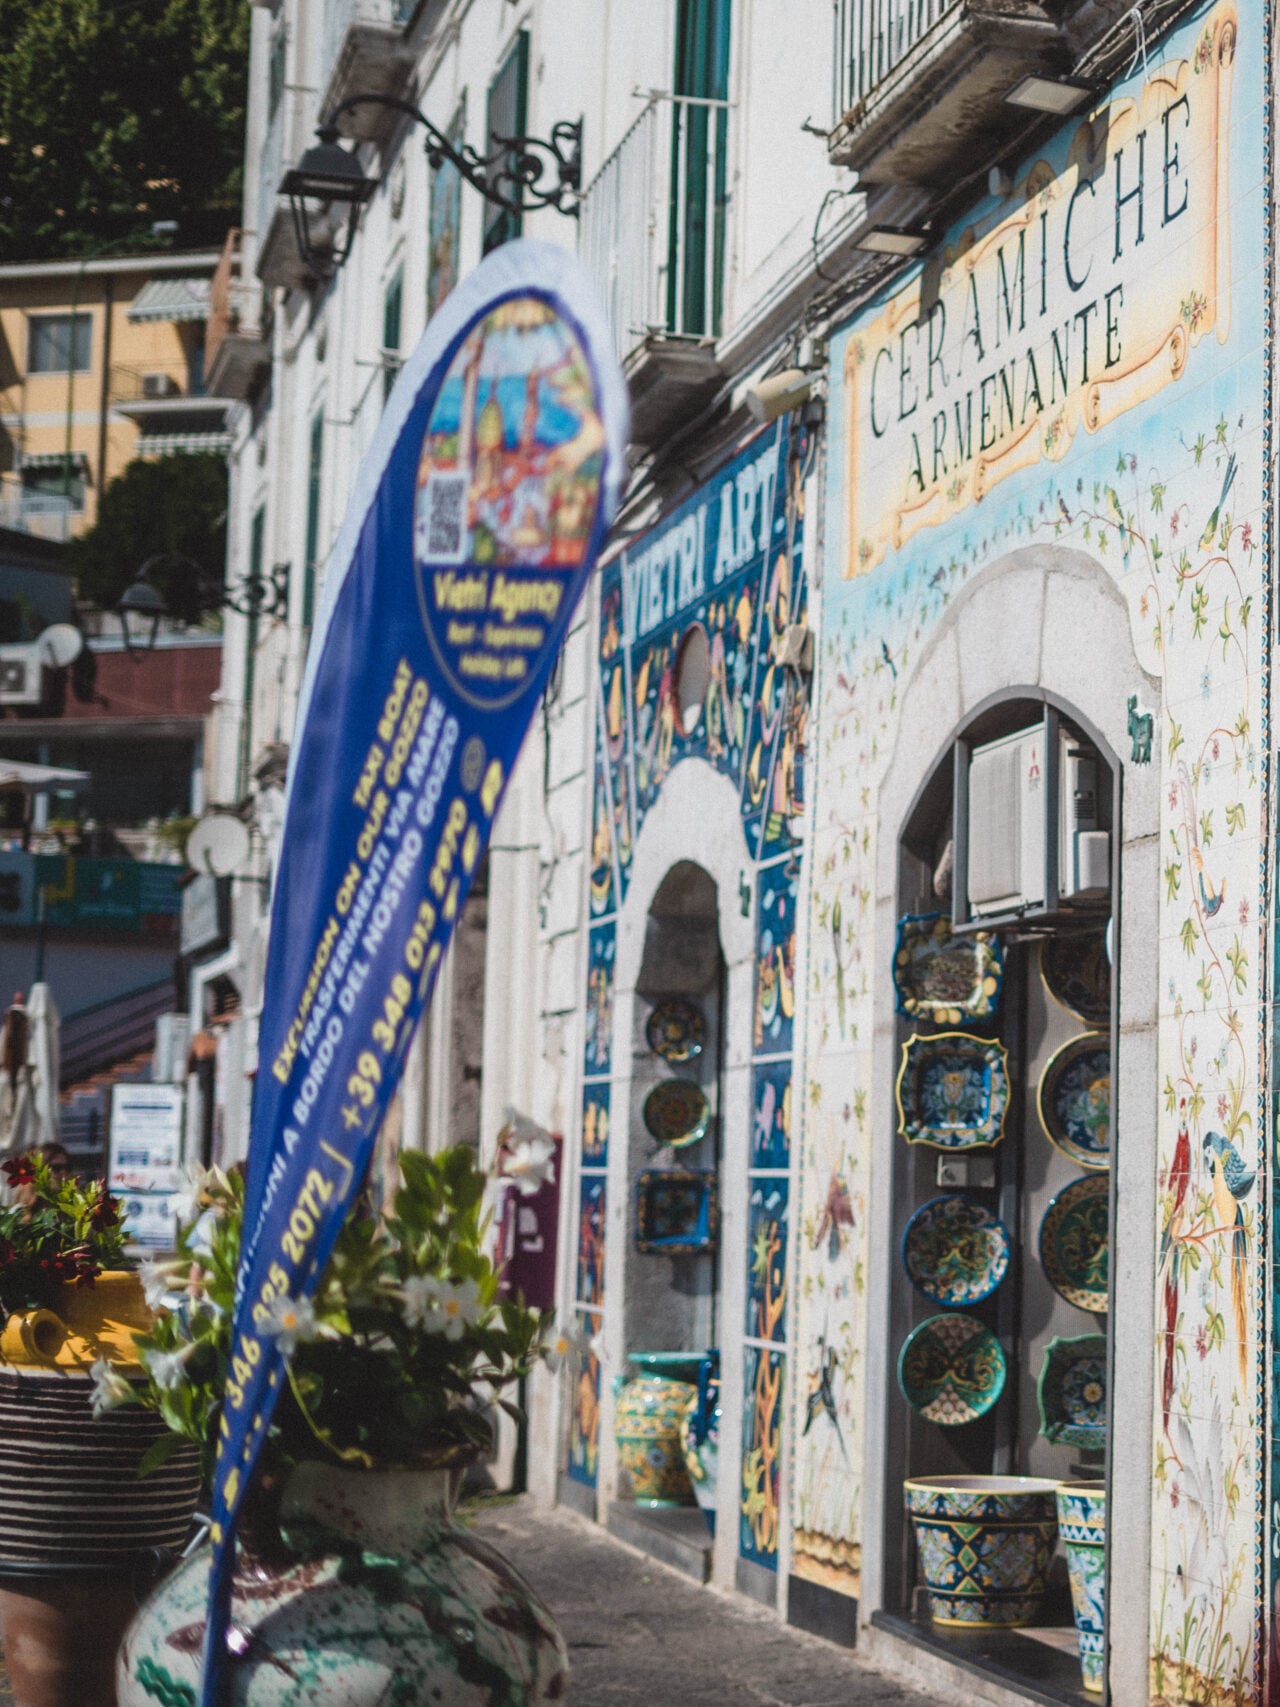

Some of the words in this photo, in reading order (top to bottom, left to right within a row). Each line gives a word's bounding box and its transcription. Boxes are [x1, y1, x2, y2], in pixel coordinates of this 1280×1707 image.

[871, 94, 1191, 438] CERAMICHE
[905, 283, 1125, 503] ARMENANTE
[624, 503, 708, 643] VIETRI
[714, 444, 778, 585] ART
[300, 841, 391, 1058] TRASFERIMENTI
[384, 790, 414, 838] VIA
[406, 697, 446, 788] MARE
[335, 863, 361, 915] ON
[357, 789, 390, 860] OUR
[384, 679, 429, 788] GOZZO
[353, 744, 384, 808] TAXI
[378, 658, 413, 742] BOAT
[293, 1016, 344, 1126] BORDO
[338, 961, 370, 1015] DEL
[362, 829, 423, 957] NOSTRO
[416, 715, 460, 827] GOZZO
[281, 1166, 336, 1265] 2072
[341, 1051, 382, 1130] +39
[371, 973, 412, 1053] 348
[405, 901, 436, 971] 013
